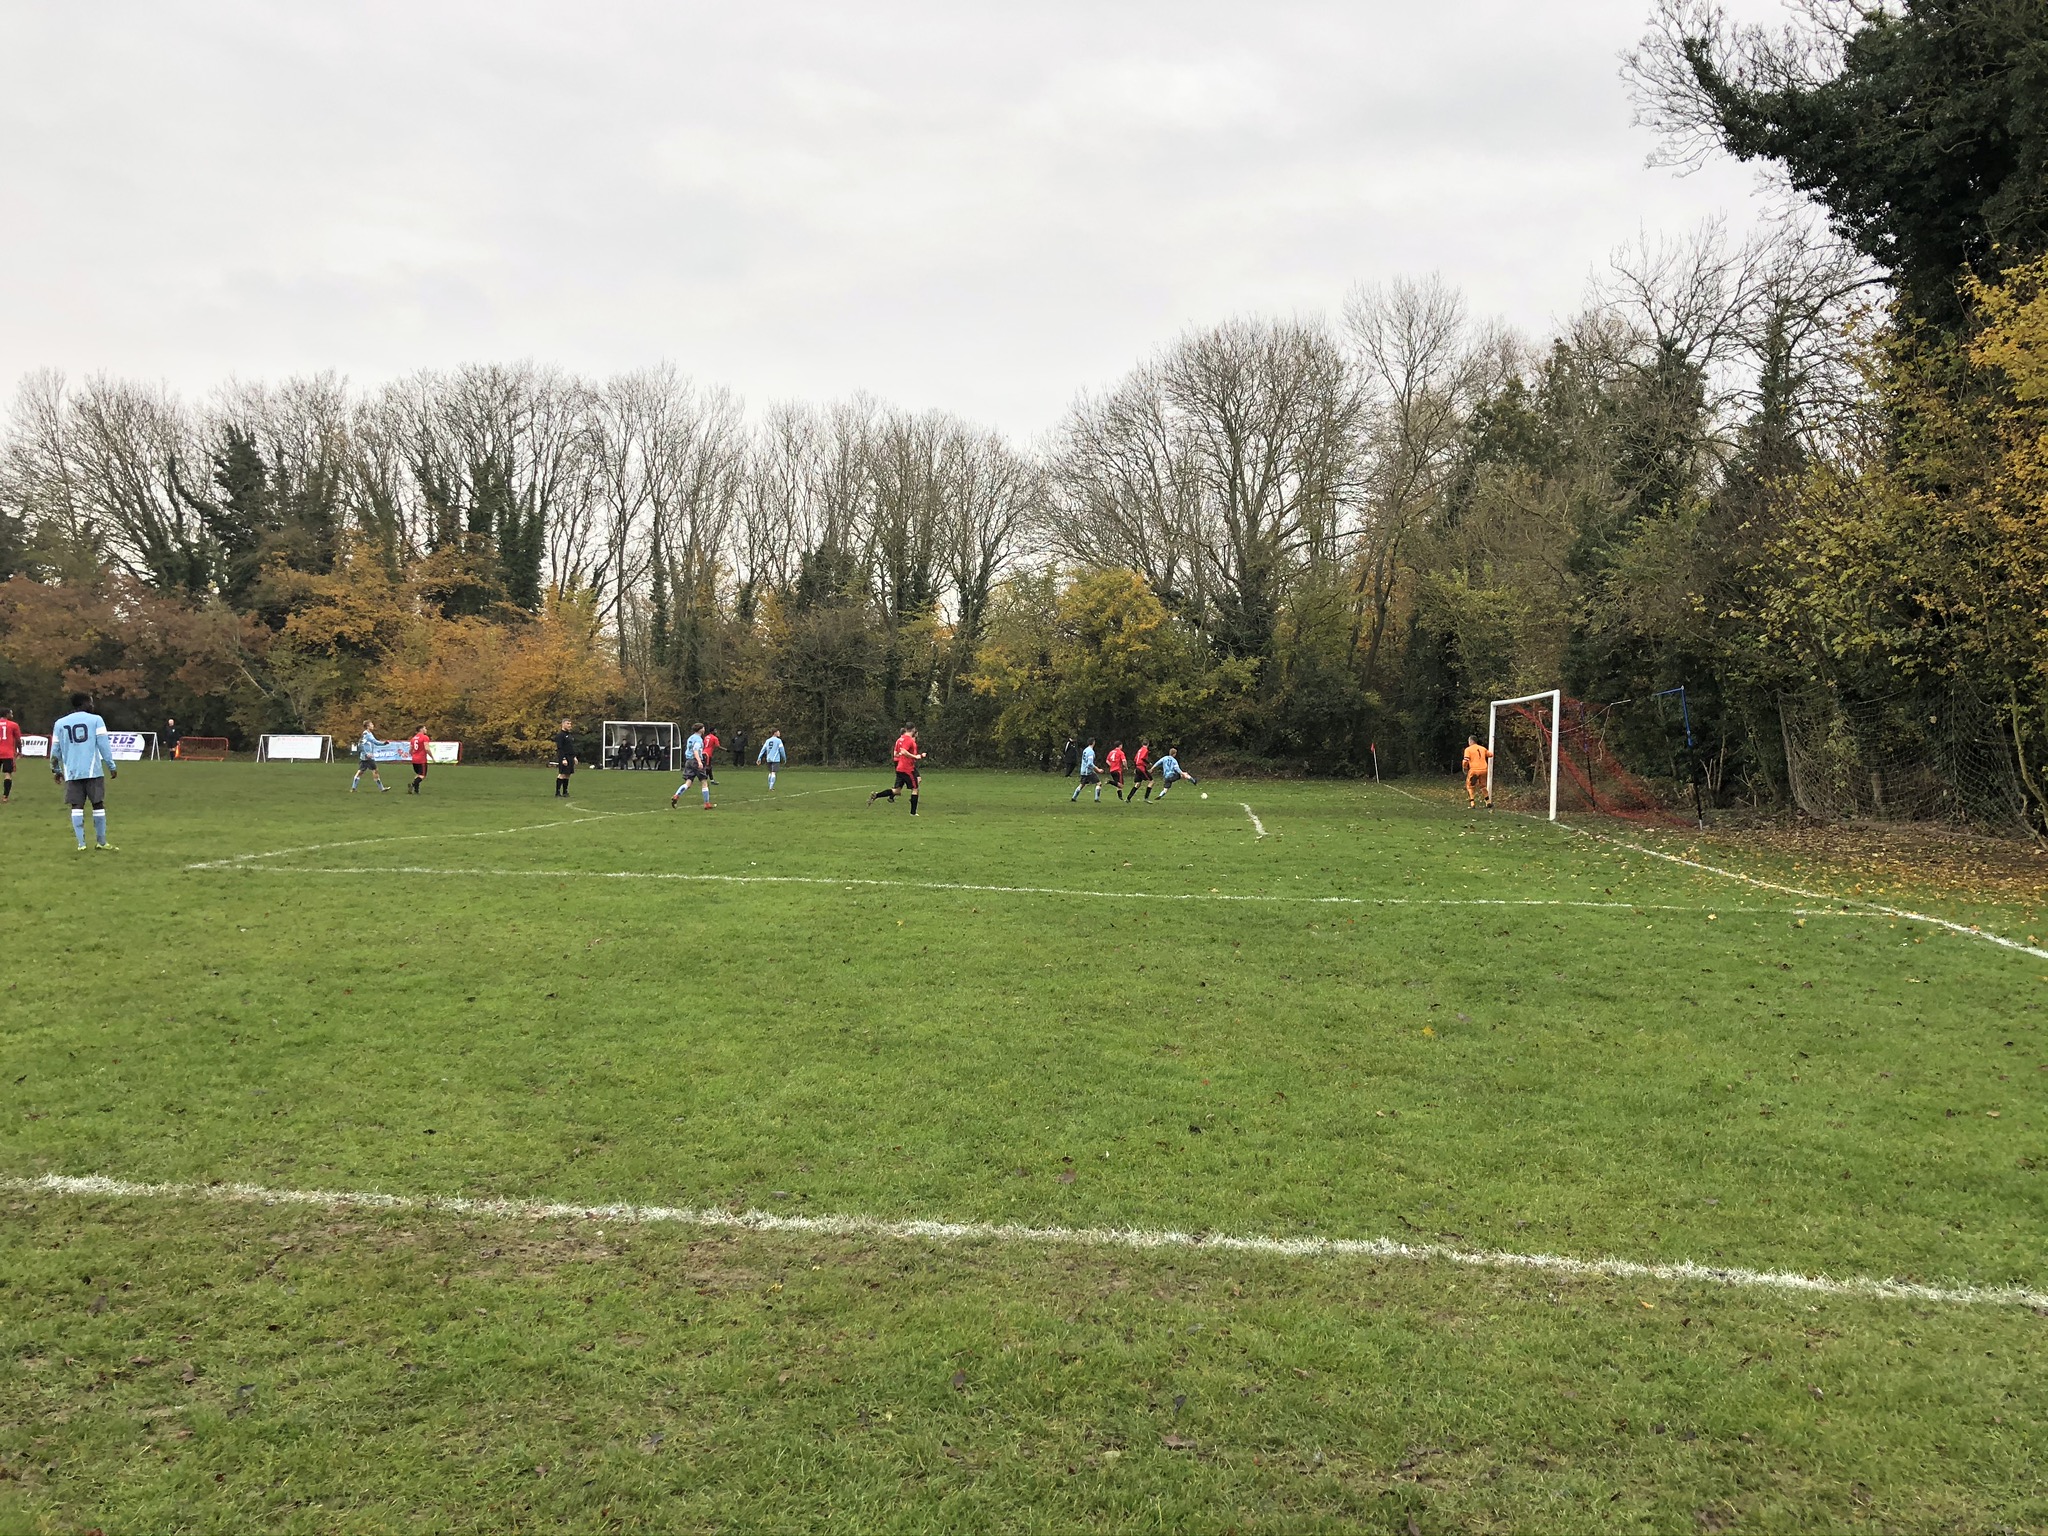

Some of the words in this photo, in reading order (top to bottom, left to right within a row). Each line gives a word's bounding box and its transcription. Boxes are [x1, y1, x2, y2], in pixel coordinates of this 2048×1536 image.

[63, 723, 88, 743] 10
[413, 739, 419, 751] 6
[768, 741, 774, 750] 9
[1110, 752, 1116, 762] 4
[1476, 748, 1482, 759] 1
